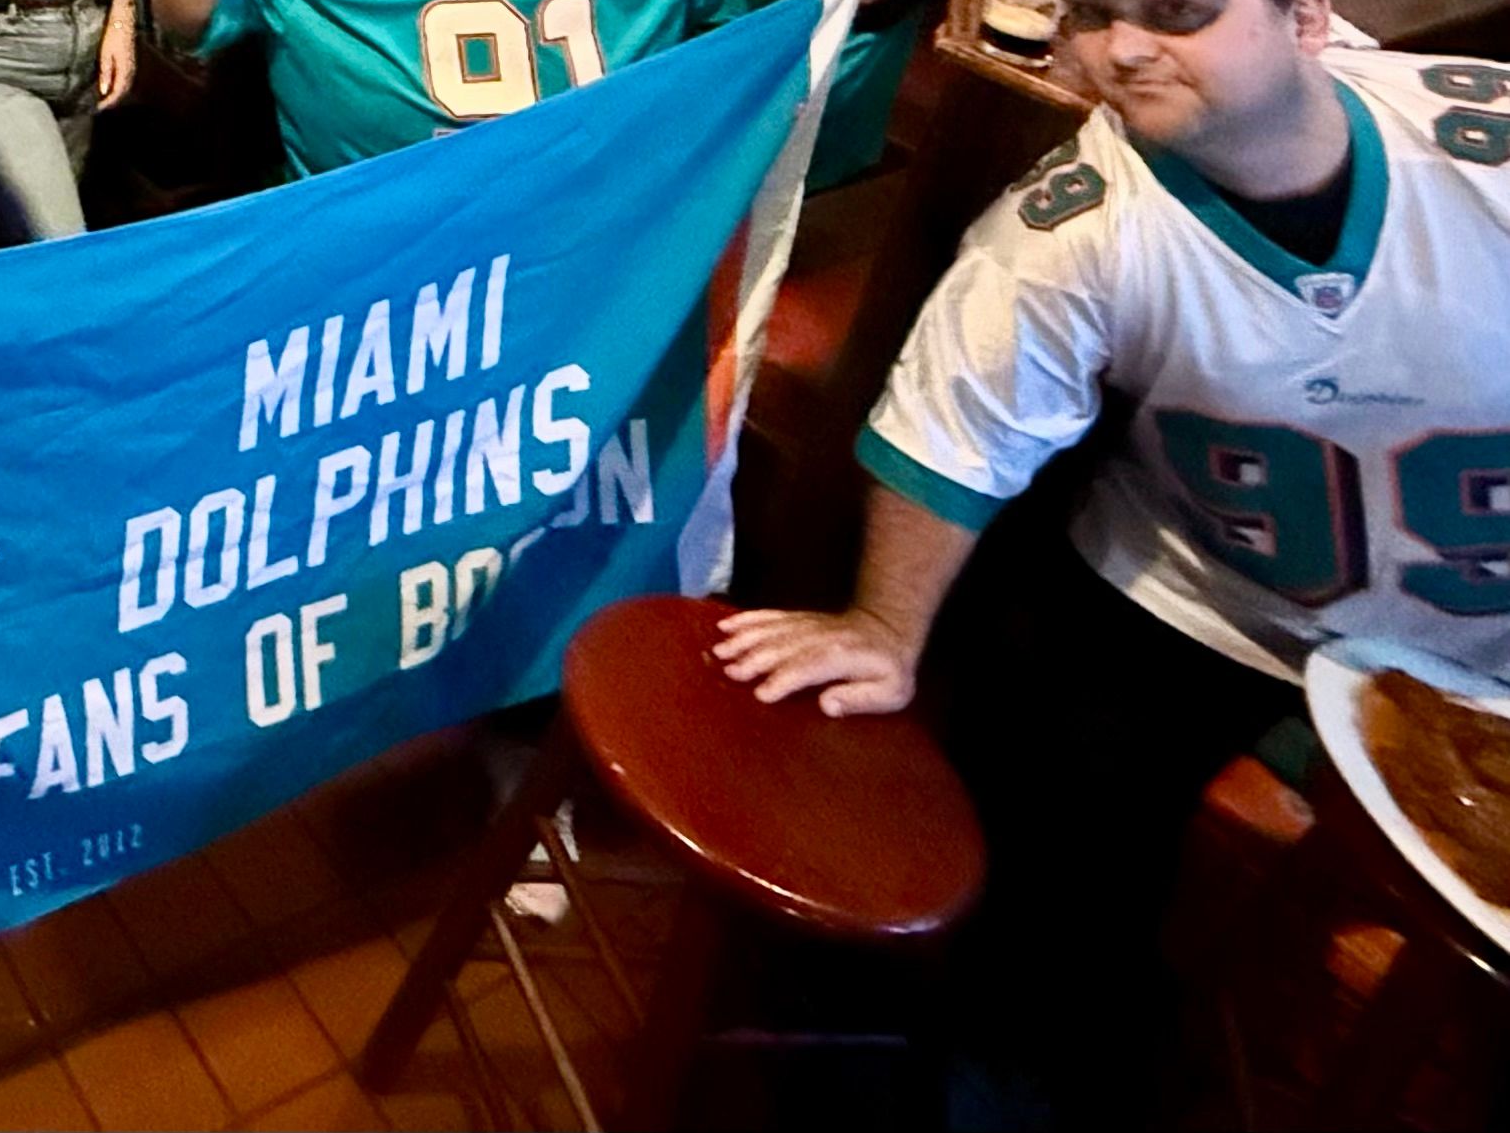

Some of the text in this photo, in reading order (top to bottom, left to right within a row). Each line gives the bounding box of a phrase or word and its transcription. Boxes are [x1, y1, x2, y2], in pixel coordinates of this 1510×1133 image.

[237, 253, 511, 453] MIAMI
[117, 364, 591, 635] DOLPHINS
[245, 594, 348, 729] OF
